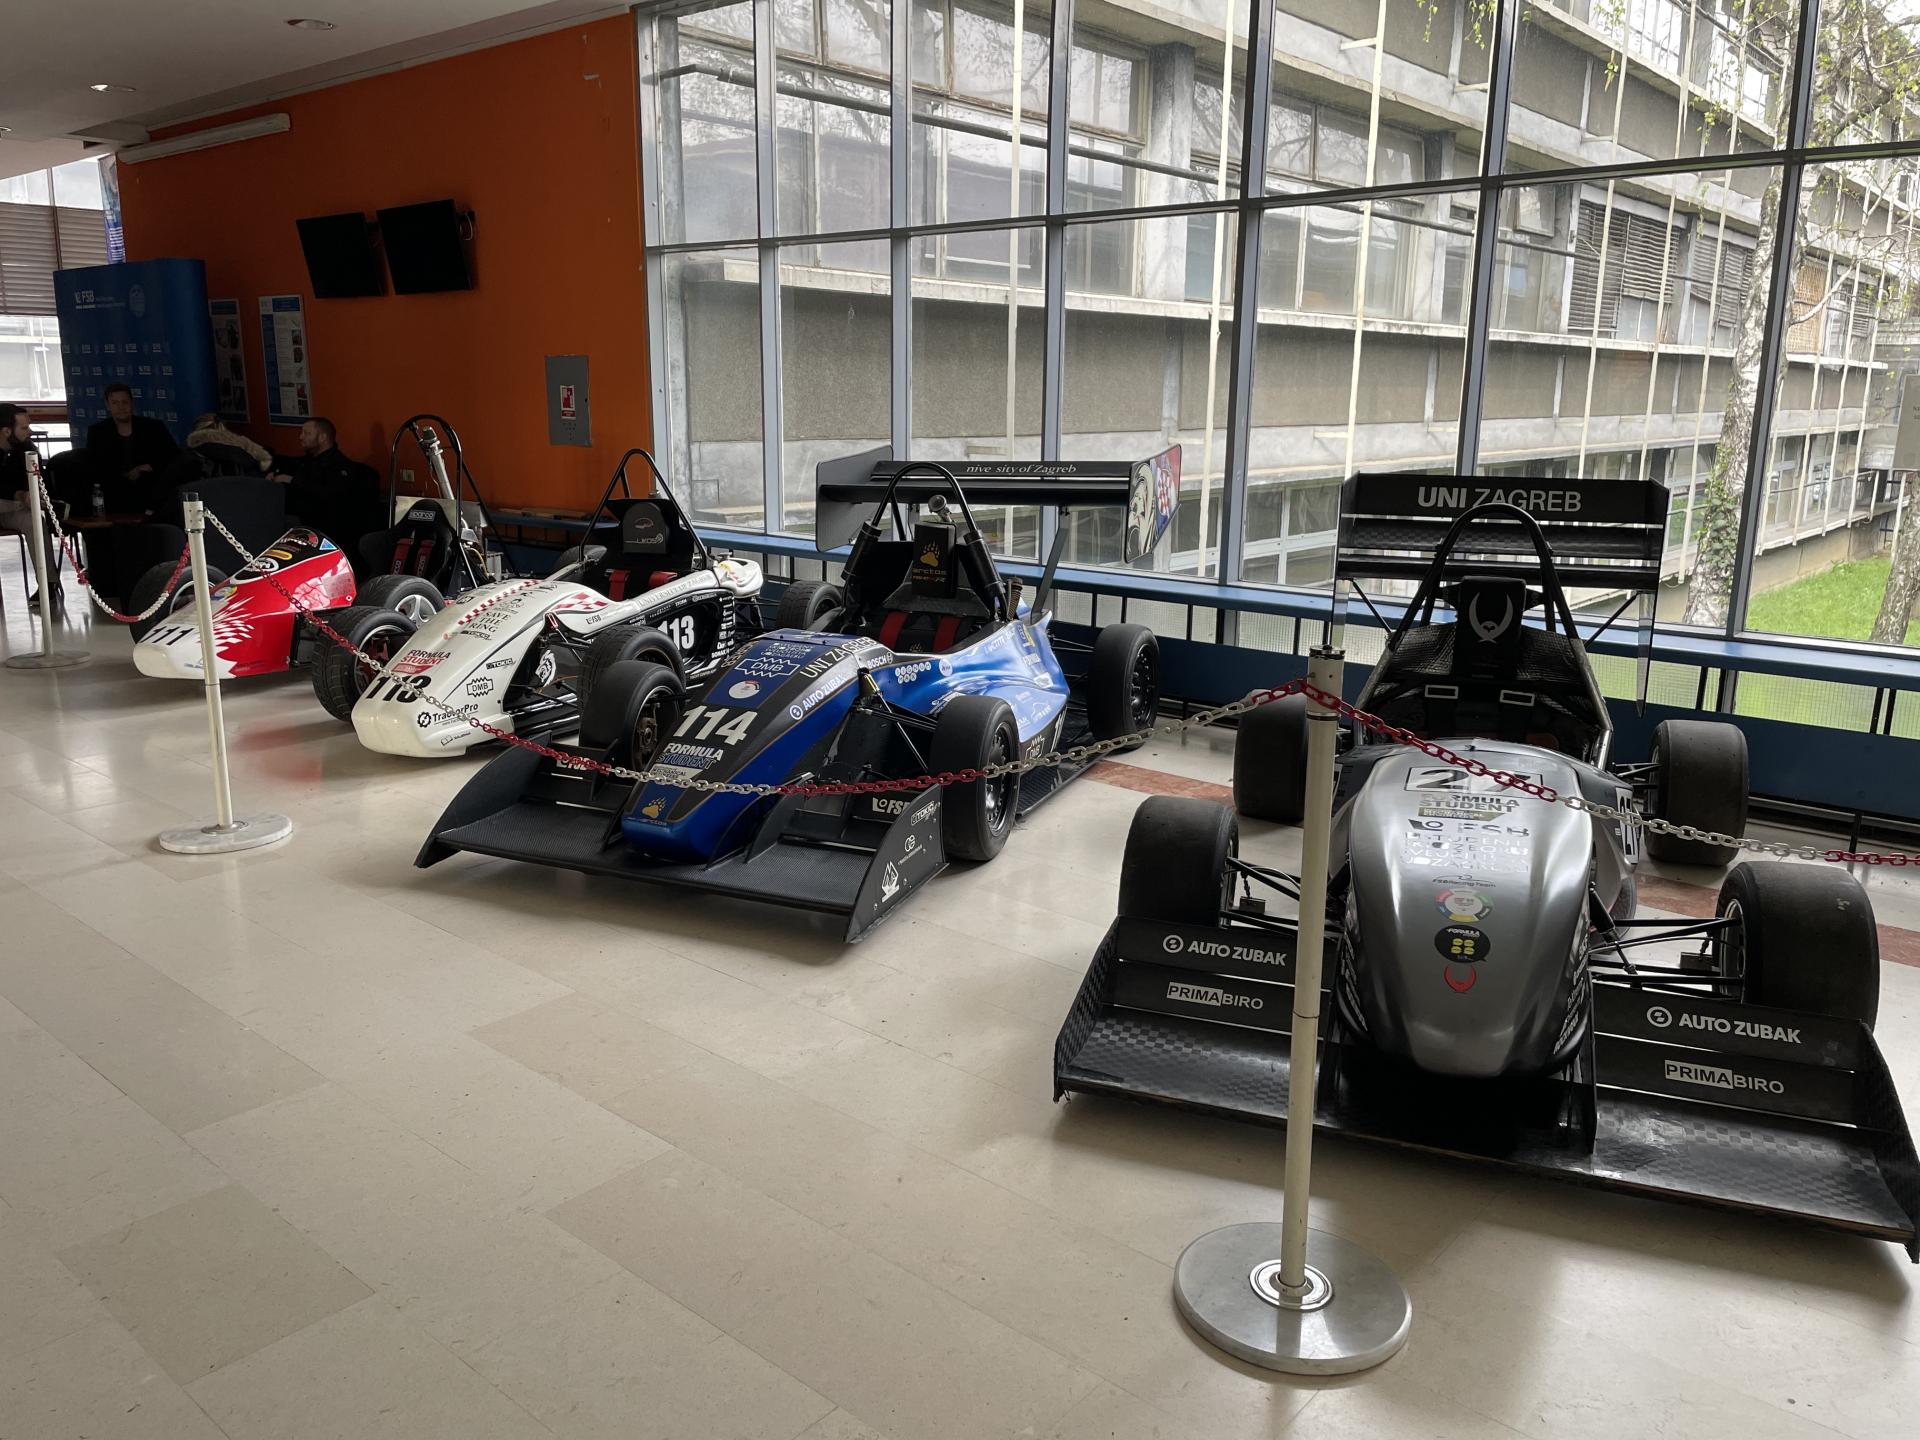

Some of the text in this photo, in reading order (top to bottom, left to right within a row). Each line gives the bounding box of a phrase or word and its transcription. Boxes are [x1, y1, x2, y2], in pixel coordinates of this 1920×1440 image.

[1018, 464, 1033, 473] of
[1033, 464, 1077, 475] Zagreb
[1417, 486, 1581, 513] UNI ZAGREB
[479, 617, 502, 626] THE
[486, 611, 511, 621] SAVE
[139, 627, 195, 646] 111
[469, 622, 498, 633] RING
[401, 655, 445, 665] STUDENT
[407, 649, 451, 659] FORMULA
[799, 658, 833, 678] UNI
[825, 636, 877, 662] ZAGREB
[867, 655, 887, 669] BOSCH
[750, 660, 785, 672] DMB
[366, 675, 432, 703] 113
[472, 682, 489, 692] DMB
[802, 688, 824, 711] AUTO
[432, 703, 479, 722] TracorPro
[673, 704, 759, 746] 114
[663, 742, 724, 761] FORMULA
[656, 753, 717, 770] STUDENT
[1419, 800, 1516, 813] STUDENT
[1187, 940, 1287, 966] AUTO ZUBAK
[1167, 984, 1264, 1010] PRIMABIRO
[1679, 1012, 1802, 1044] AUTO ZUBAK
[1666, 1063, 1785, 1094] PRIMABIRO
